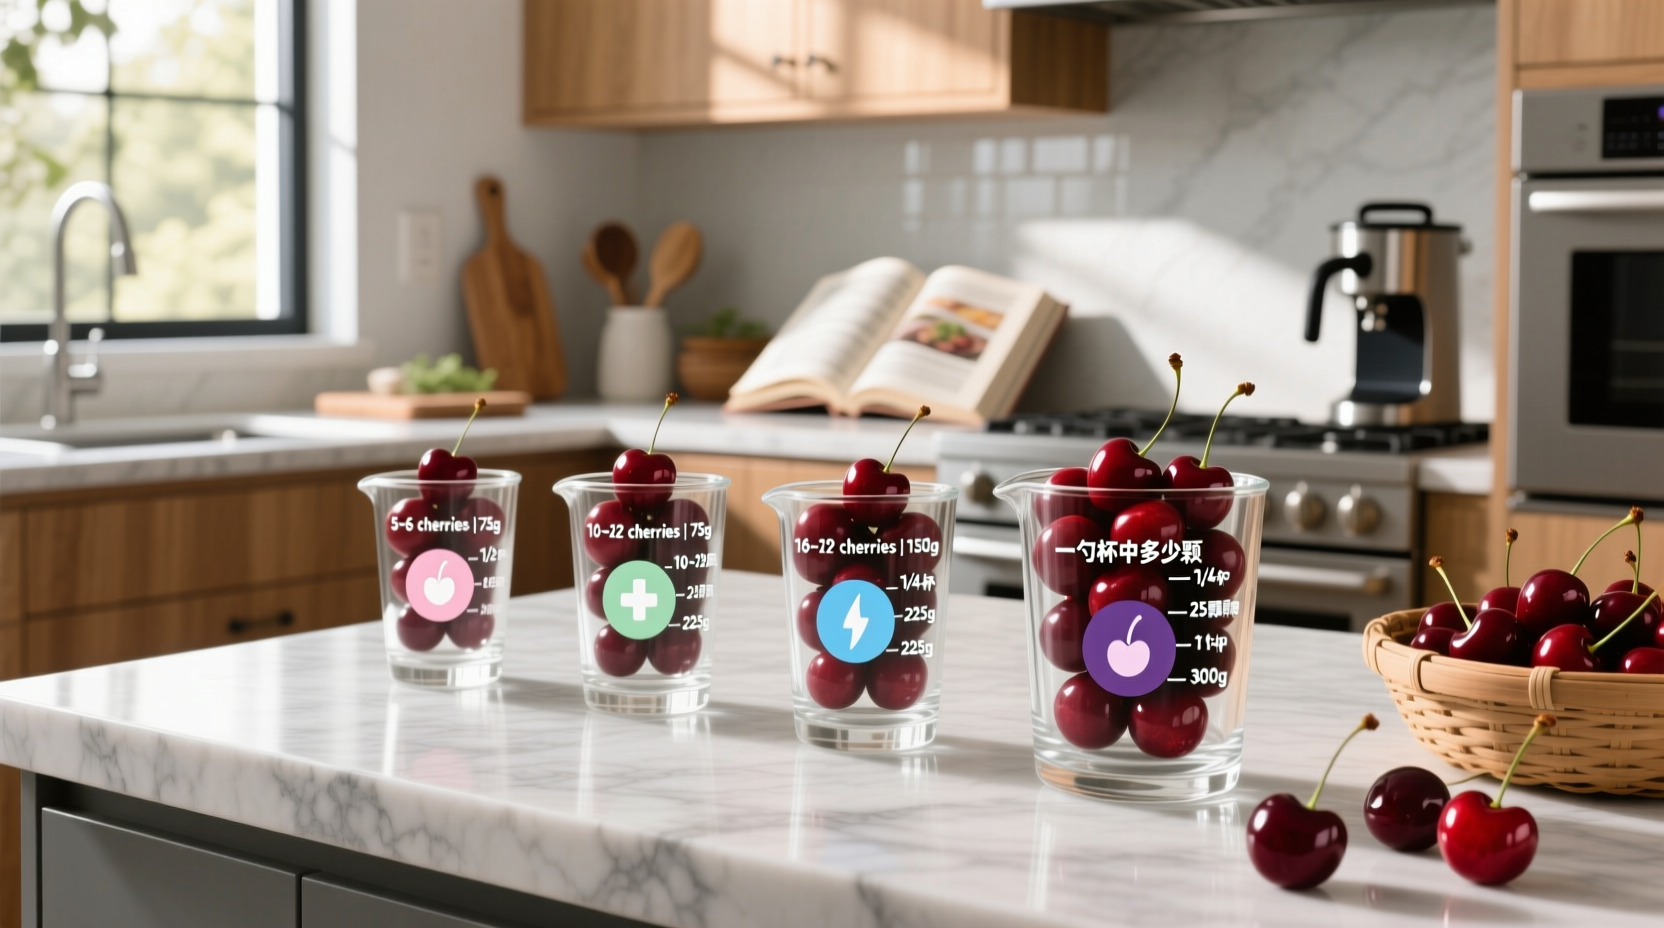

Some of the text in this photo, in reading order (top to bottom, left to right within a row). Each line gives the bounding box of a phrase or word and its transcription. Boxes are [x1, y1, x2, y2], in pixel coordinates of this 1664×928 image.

[390, 516, 414, 531] 5-6
[417, 516, 470, 532] cherries
[478, 516, 501, 535] 75g
[587, 523, 624, 539] 10-22
[627, 523, 681, 539] cherries
[690, 522, 712, 540] 75g
[794, 538, 835, 554] 16-22
[839, 538, 897, 554] cherries
[906, 537, 940, 557] 150g
[1055, 539, 1203, 565] 一勺杯中多少颗
[682, 615, 710, 631] 225g
[903, 605, 936, 624] 225g
[900, 640, 934, 658] 225g
[1189, 667, 1228, 687] 300g
